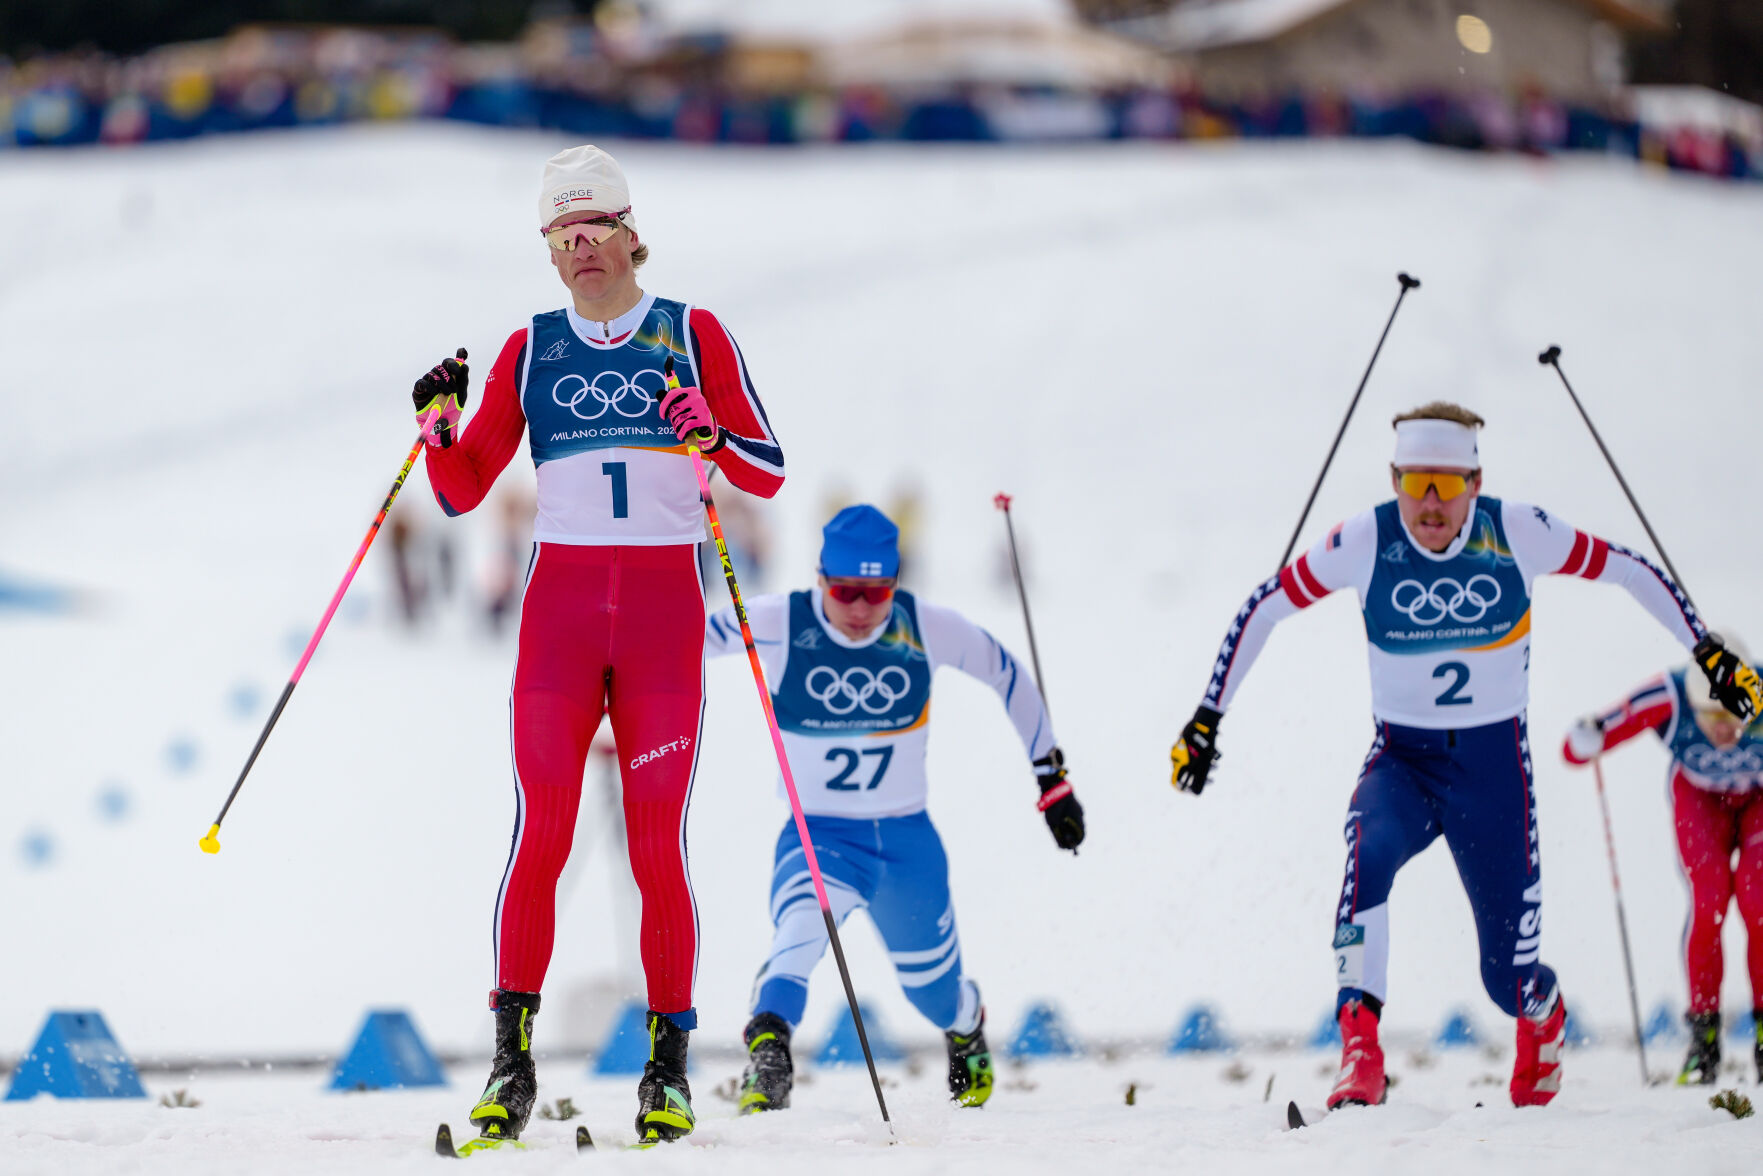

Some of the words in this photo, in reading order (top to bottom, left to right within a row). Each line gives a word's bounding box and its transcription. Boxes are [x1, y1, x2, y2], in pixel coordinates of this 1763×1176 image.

[553, 189, 593, 204] NORGE
[550, 428, 598, 441] MILANO
[599, 426, 655, 436] CORTINA
[657, 426, 675, 435] 202
[601, 461, 629, 519] 1
[1385, 630, 1434, 640] MILANO
[1431, 660, 1474, 707] 2
[630, 740, 679, 770] CRAFT
[824, 744, 895, 792] 27
[1512, 878, 1542, 966] USA
[1337, 954, 1347, 974] 2
